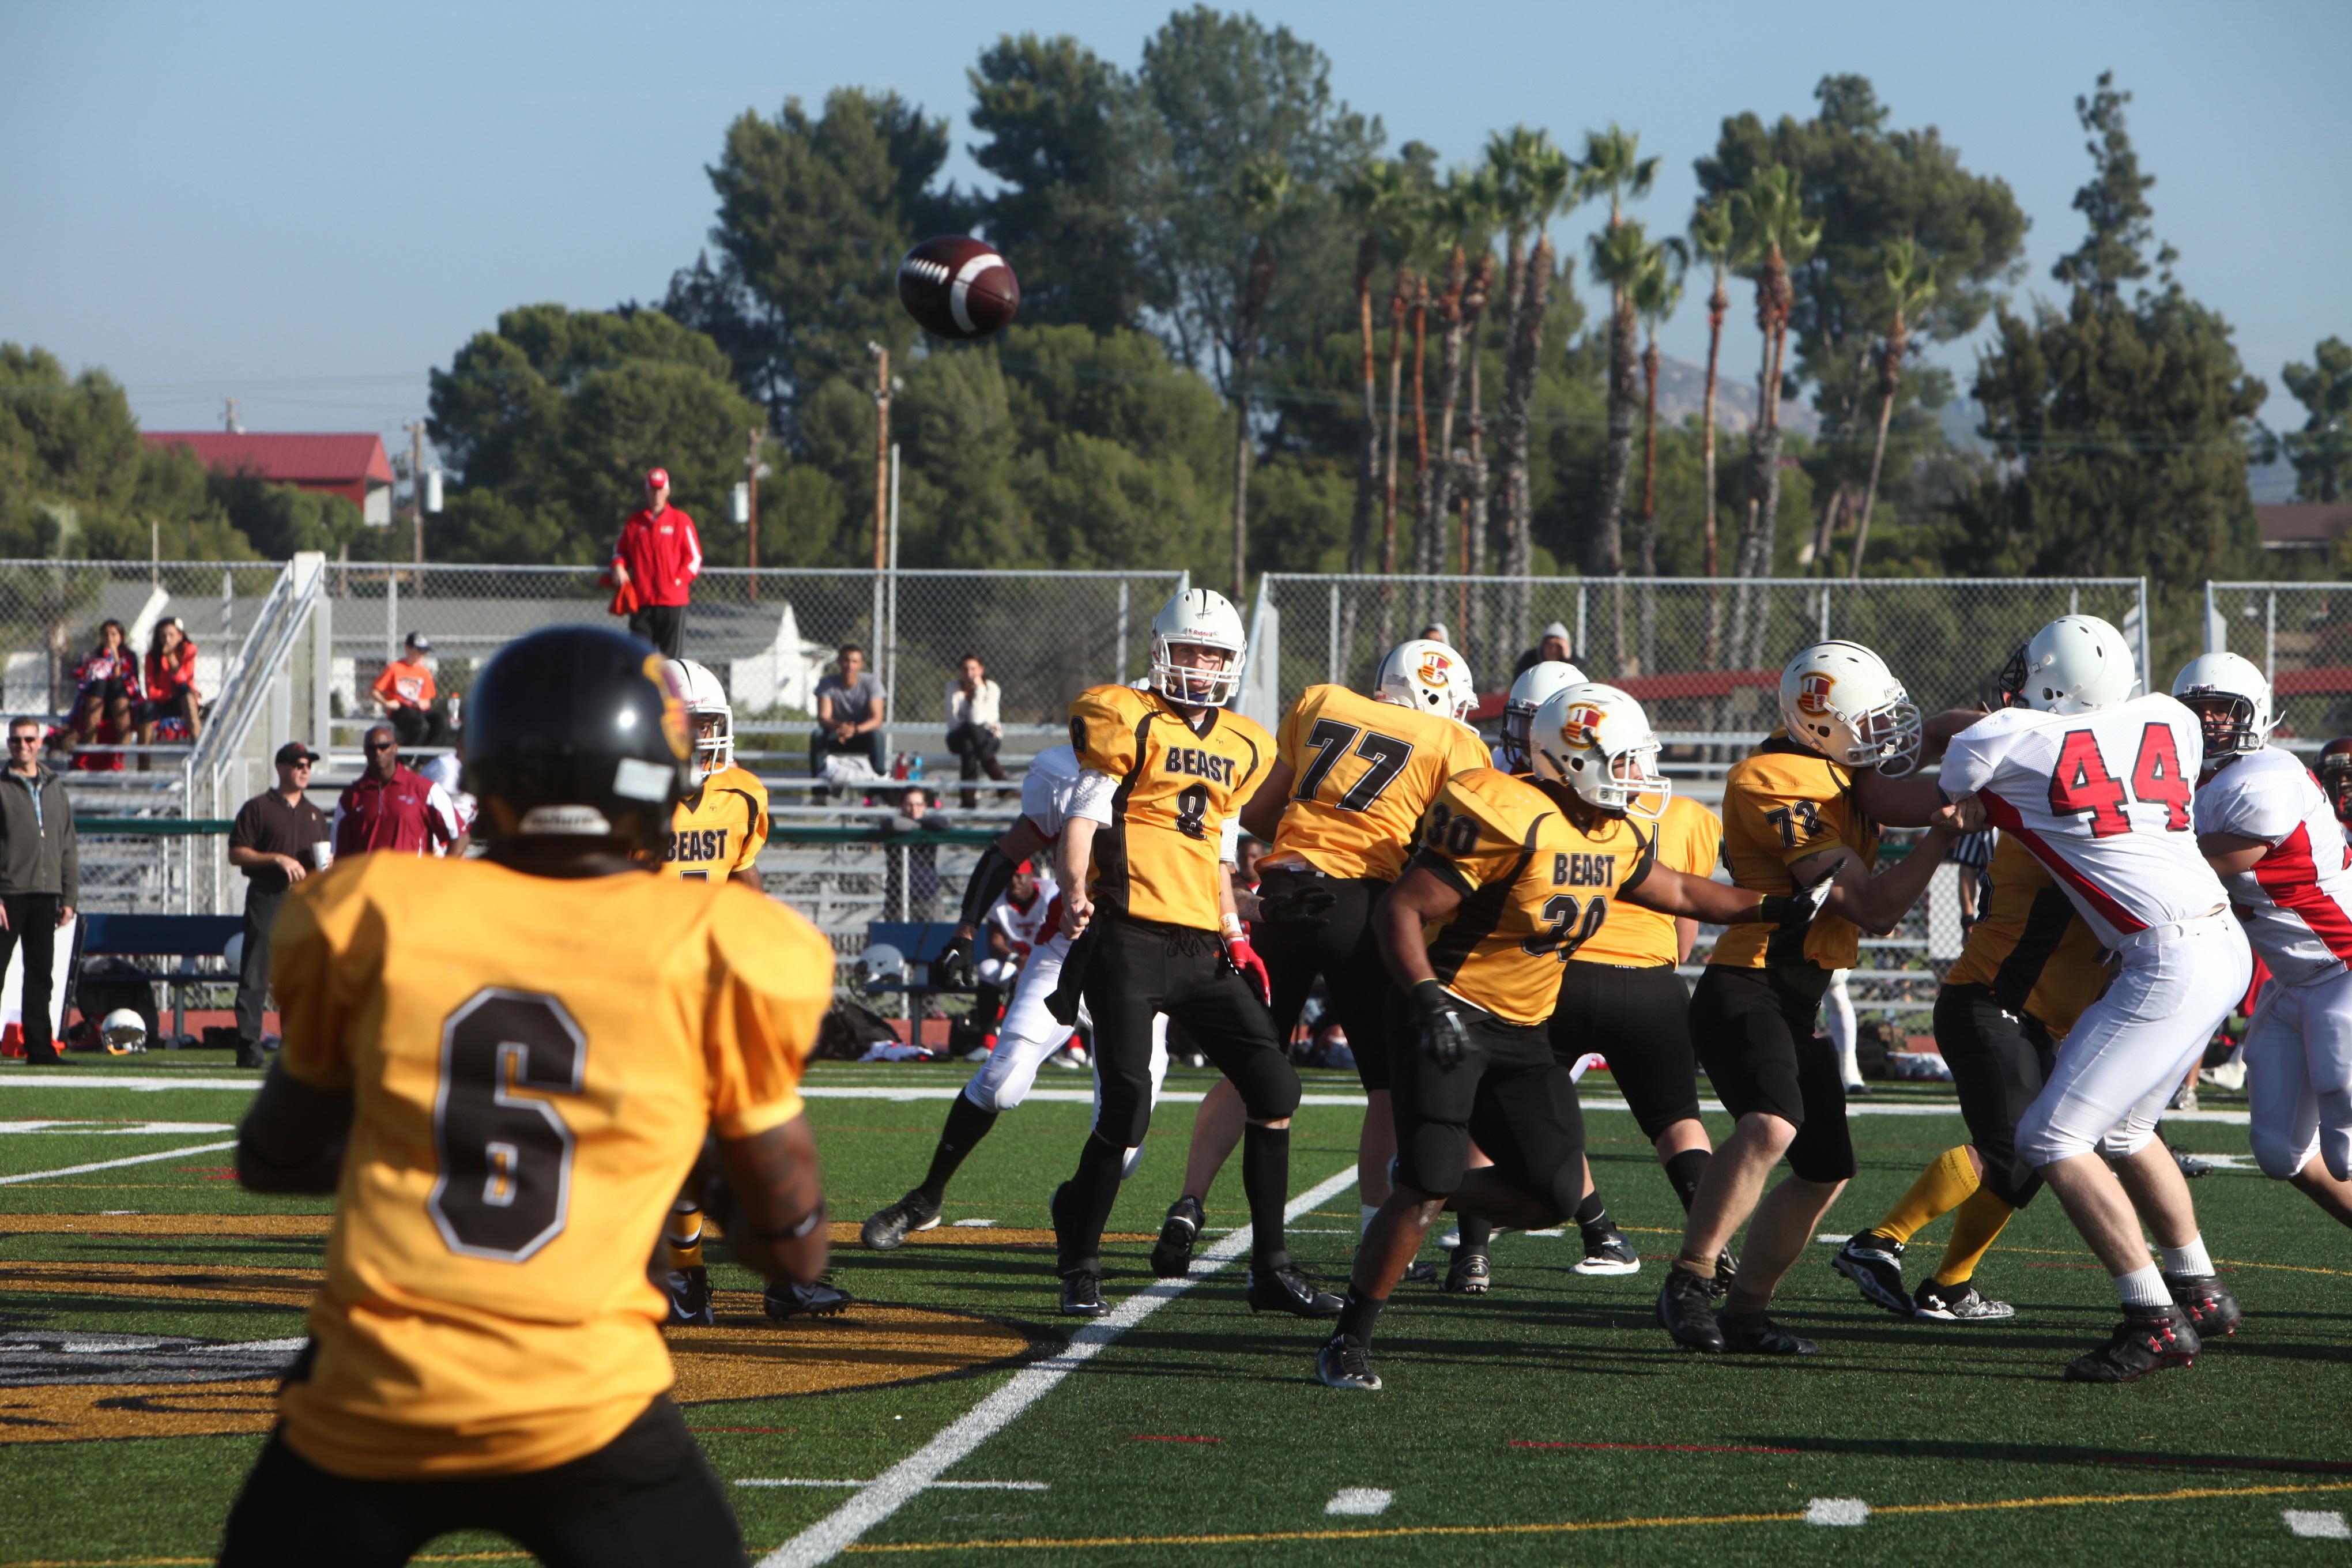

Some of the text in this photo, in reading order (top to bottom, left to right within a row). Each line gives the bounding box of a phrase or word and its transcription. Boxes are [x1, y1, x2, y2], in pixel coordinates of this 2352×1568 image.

[1807, 679, 1812, 693] 1
[1575, 709, 1582, 722] 1
[1164, 745, 1235, 788] BEAST
[1292, 717, 1415, 812] 77
[2048, 722, 2191, 839] 44
[1176, 783, 1209, 841] 8
[1427, 802, 1482, 856] 30
[1765, 799, 1825, 849] 72
[666, 828, 728, 862] BEAST
[1552, 853, 1616, 888] BEAST
[426, 985, 588, 1264] 6
